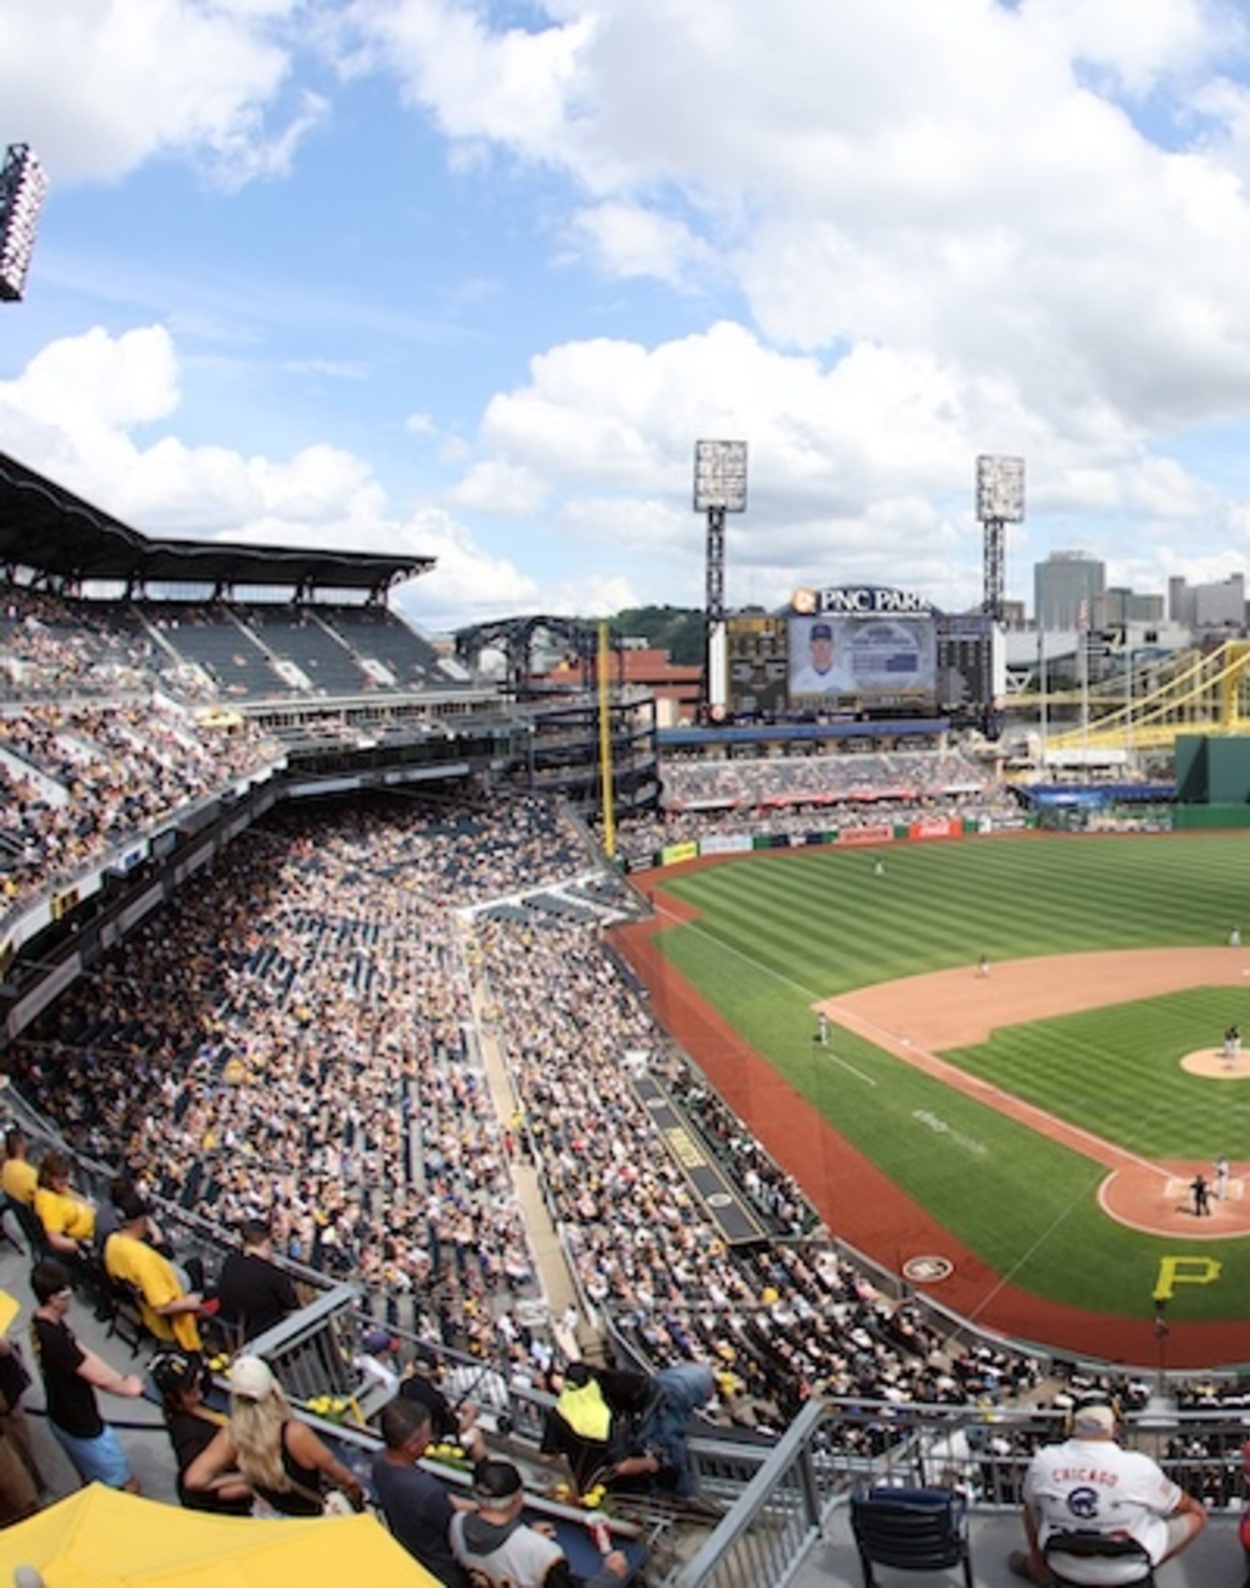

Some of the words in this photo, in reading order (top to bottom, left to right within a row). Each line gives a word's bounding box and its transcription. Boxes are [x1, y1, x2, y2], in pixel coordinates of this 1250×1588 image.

[820, 590, 870, 610] PNC
[874, 590, 932, 610] PARK
[1151, 1255, 1223, 1301] P
[1053, 1467, 1118, 1488] CHICAGO
